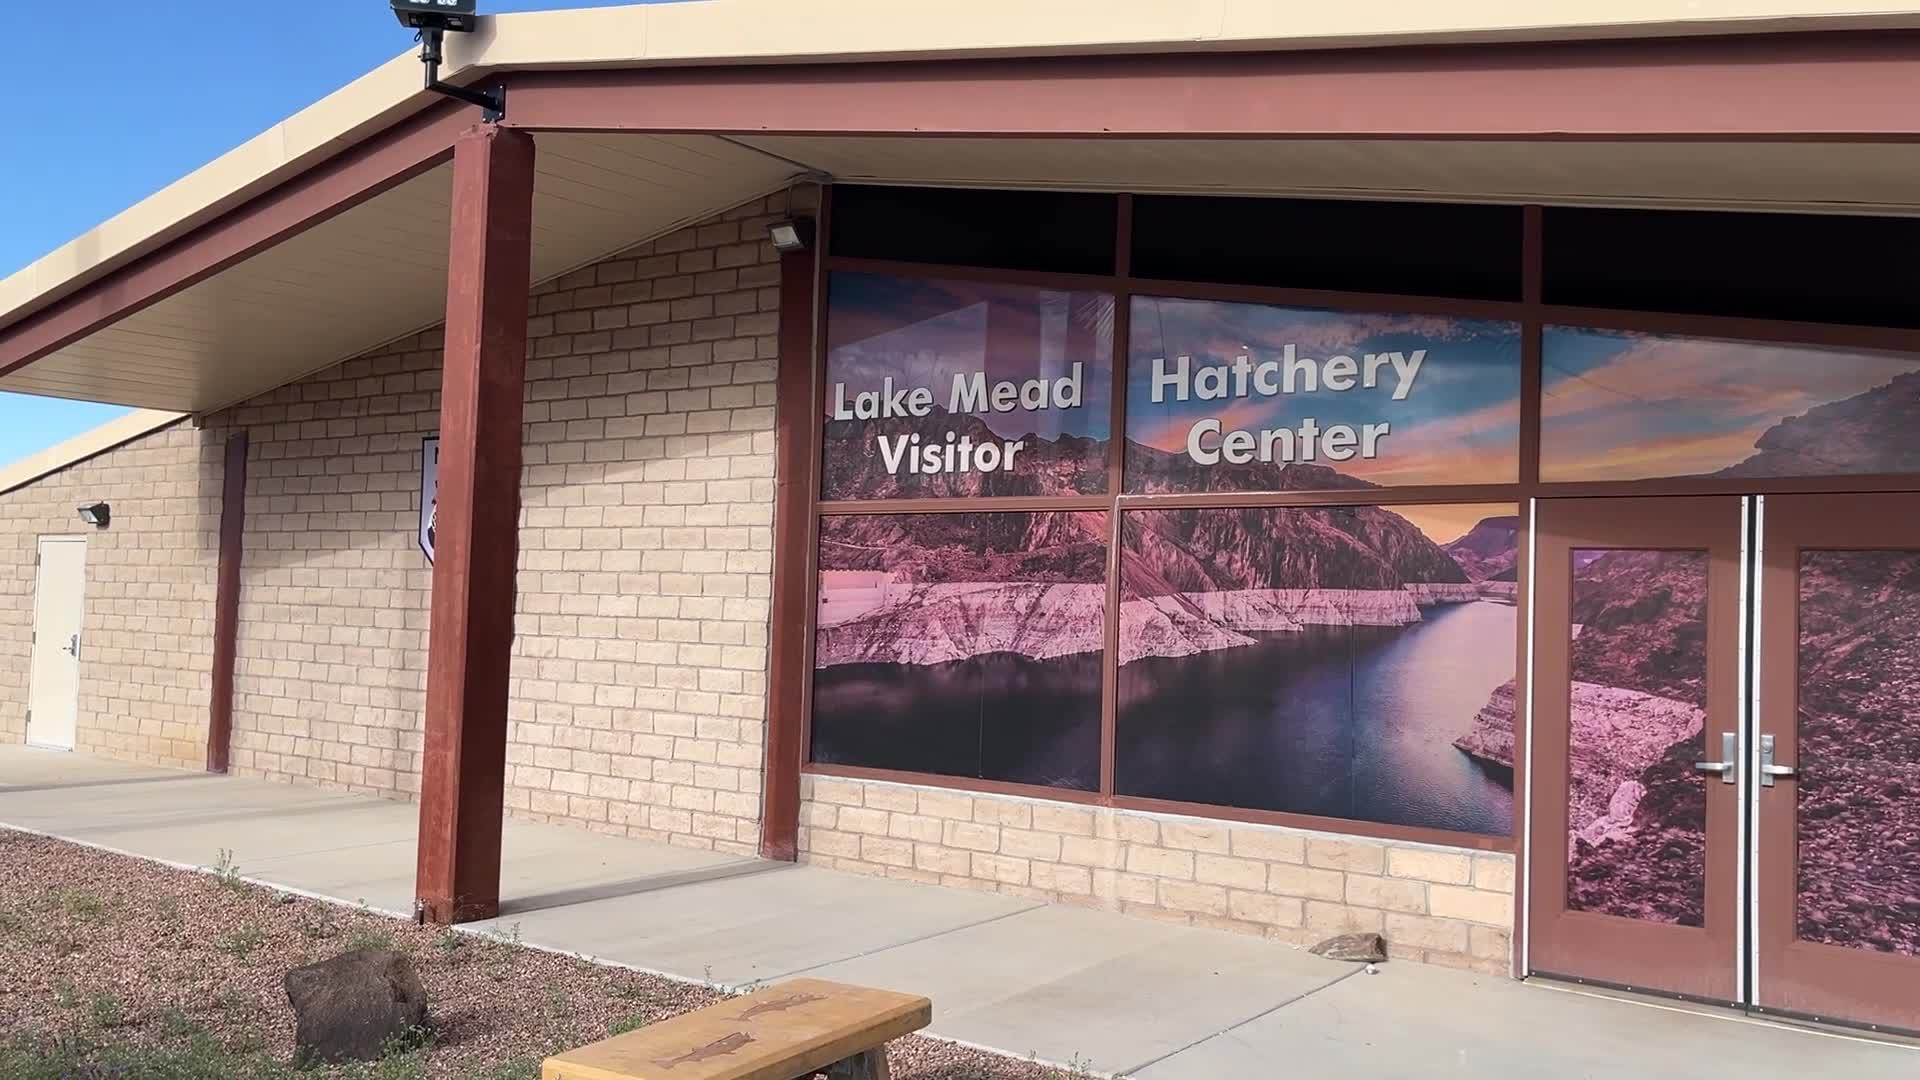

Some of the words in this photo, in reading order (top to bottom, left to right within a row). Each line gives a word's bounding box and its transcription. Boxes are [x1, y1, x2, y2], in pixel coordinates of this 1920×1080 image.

[834, 377, 933, 421] Lake
[948, 362, 1083, 415] Mead
[1151, 344, 1427, 403] Hatchery
[877, 431, 1024, 475] Visitor
[1187, 418, 1390, 466] Center
